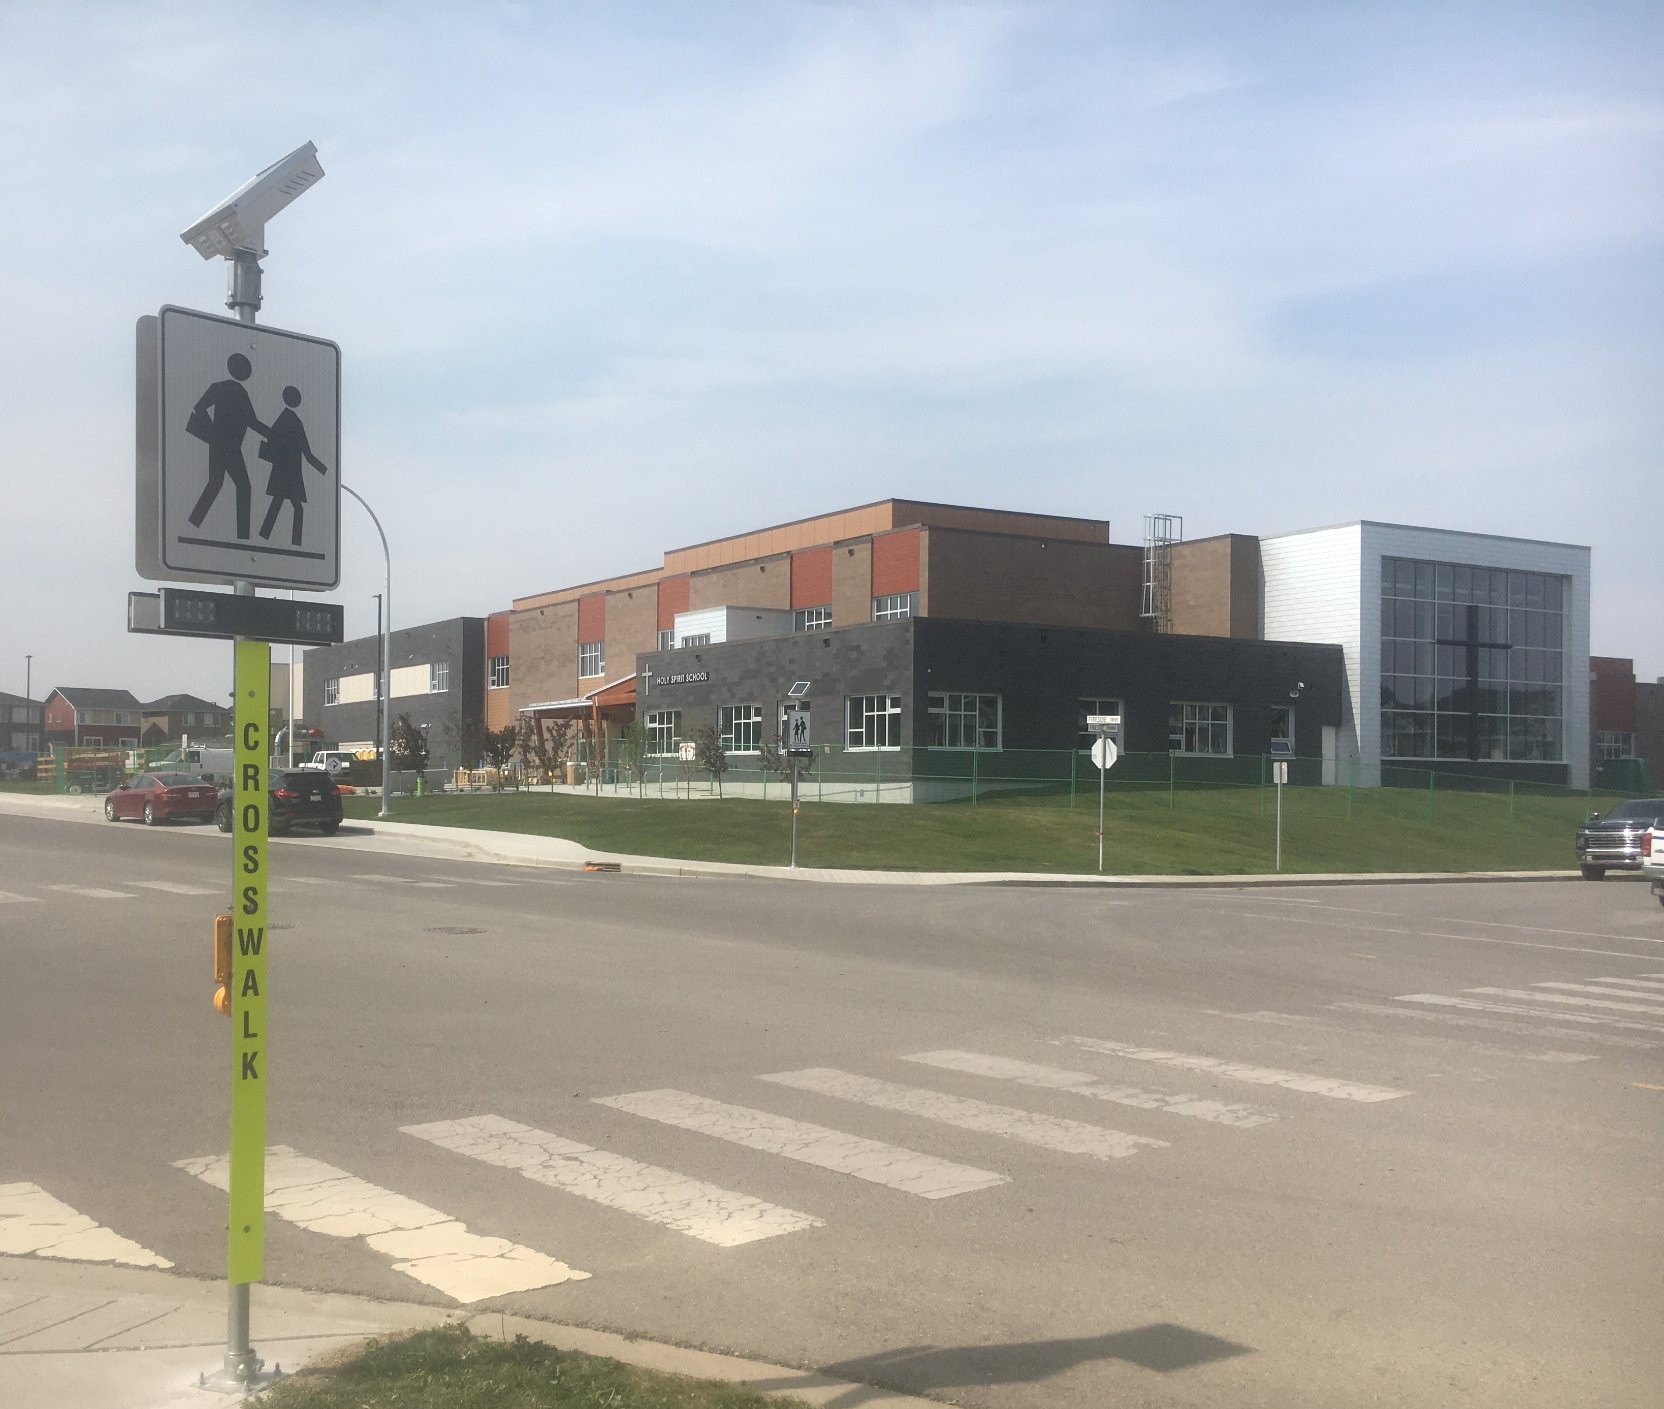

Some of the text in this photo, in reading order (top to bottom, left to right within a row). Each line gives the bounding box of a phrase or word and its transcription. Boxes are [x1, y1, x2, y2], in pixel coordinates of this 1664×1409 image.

[656, 671, 708, 685] HOLY SPIRIT SCHOOL
[237, 722, 264, 1080] CROSSWALK
